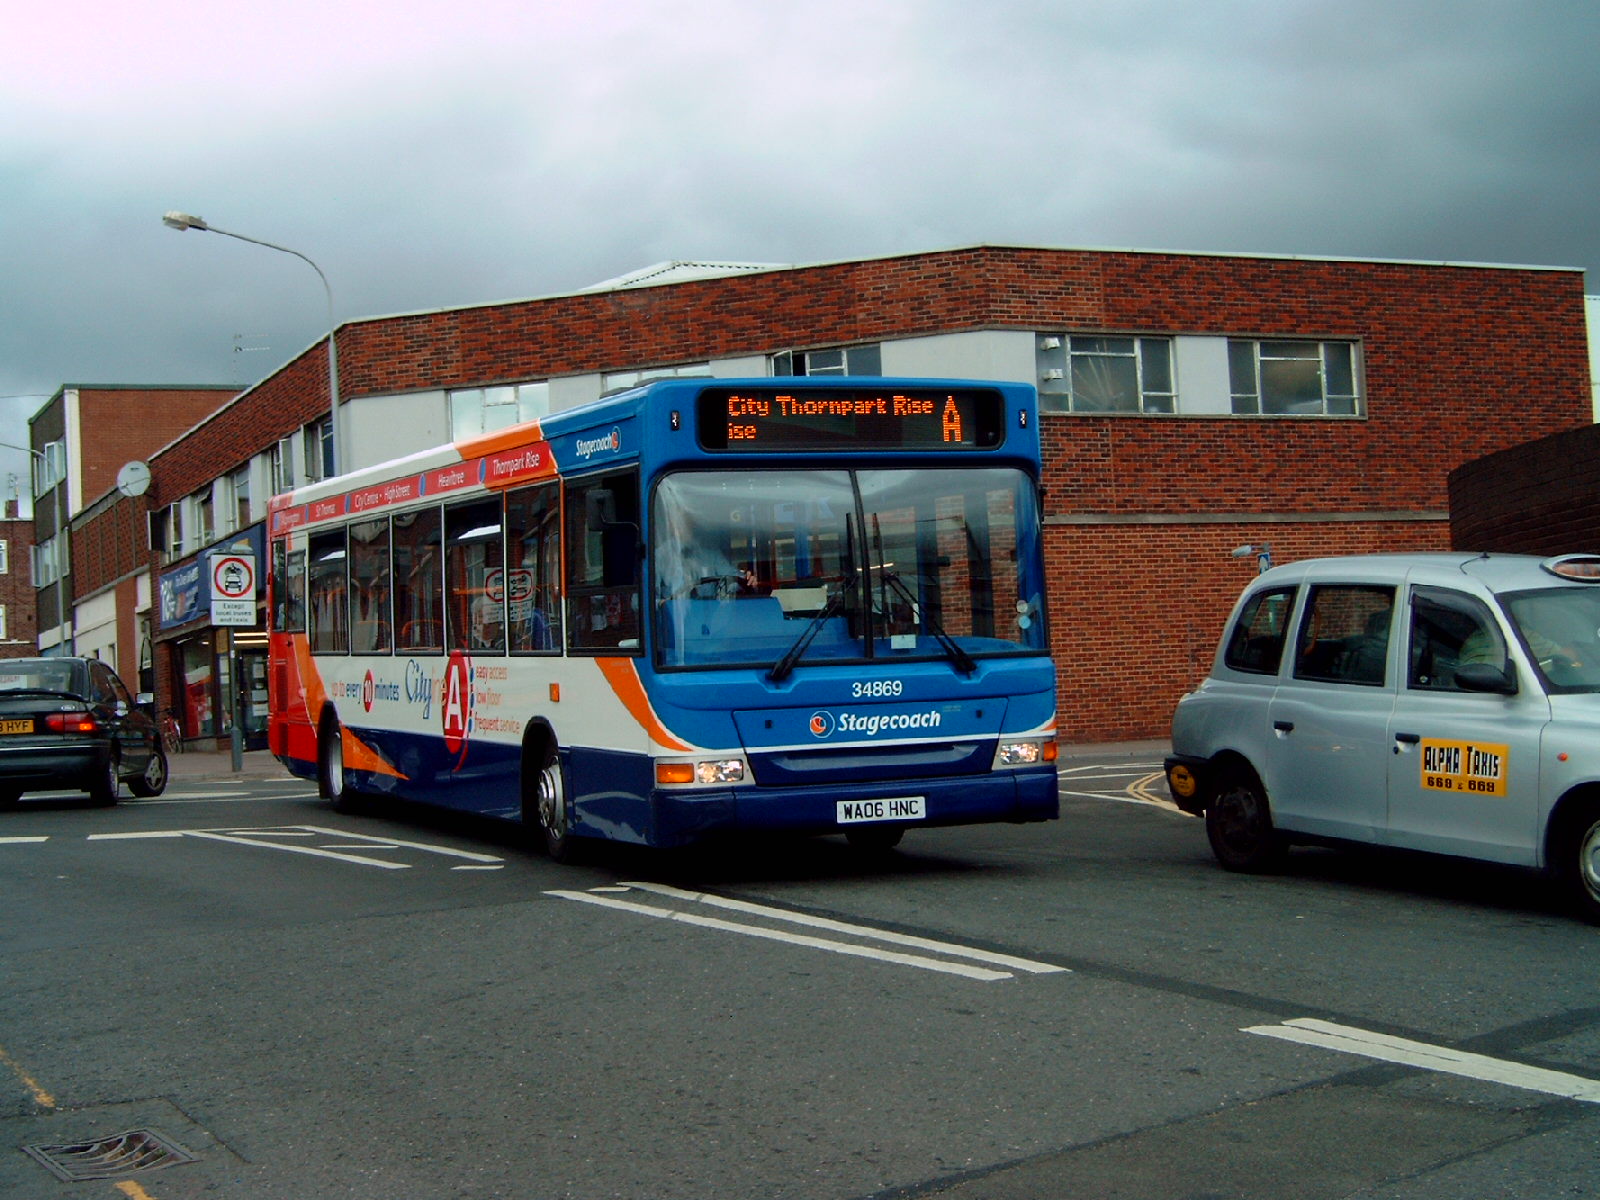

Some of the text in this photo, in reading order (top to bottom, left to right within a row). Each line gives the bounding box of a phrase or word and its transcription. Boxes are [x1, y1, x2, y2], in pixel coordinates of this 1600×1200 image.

[728, 395, 934, 416] City Thornpark Rise
[942, 395, 963, 442] A
[576, 431, 612, 460] Stagecoach
[493, 450, 541, 477] Thornpark Rise
[346, 682, 361, 705] every
[375, 677, 400, 702] minutes
[851, 680, 903, 698] 34869
[838, 710, 941, 736] Stagecoach
[843, 800, 919, 819] WA06 HNC
